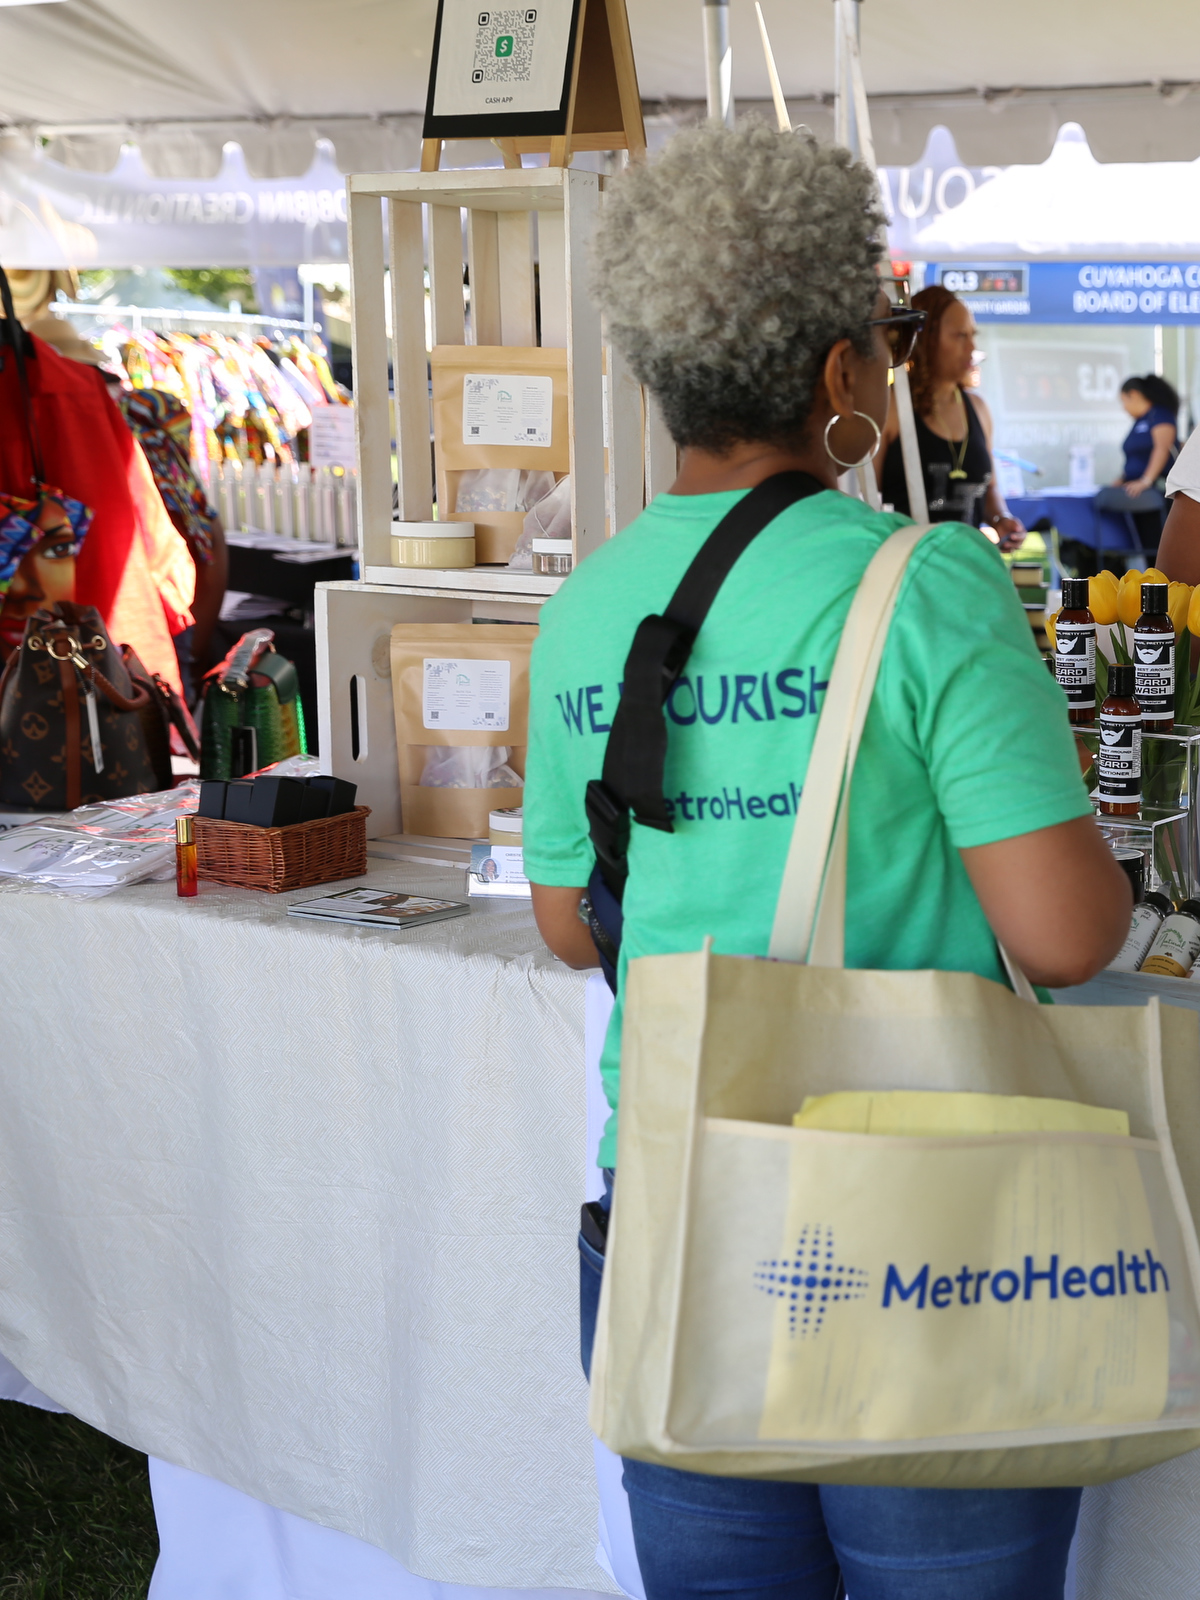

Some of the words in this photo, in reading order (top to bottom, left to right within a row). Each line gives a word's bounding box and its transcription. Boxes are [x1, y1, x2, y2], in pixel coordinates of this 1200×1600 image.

[1079, 265, 1183, 288] CUYAHOGA
[1073, 290, 1137, 314] BOARD
[1139, 291, 1167, 314] OF
[1056, 668, 1083, 676] EARD
[555, 684, 611, 738] WE
[618, 665, 830, 726] OURISH
[664, 782, 802, 821] etroHeal
[102, 851, 142, 860] HAIR
[1156, 933, 1186, 950] Natural
[882, 1248, 1170, 1310] MetroHealth
